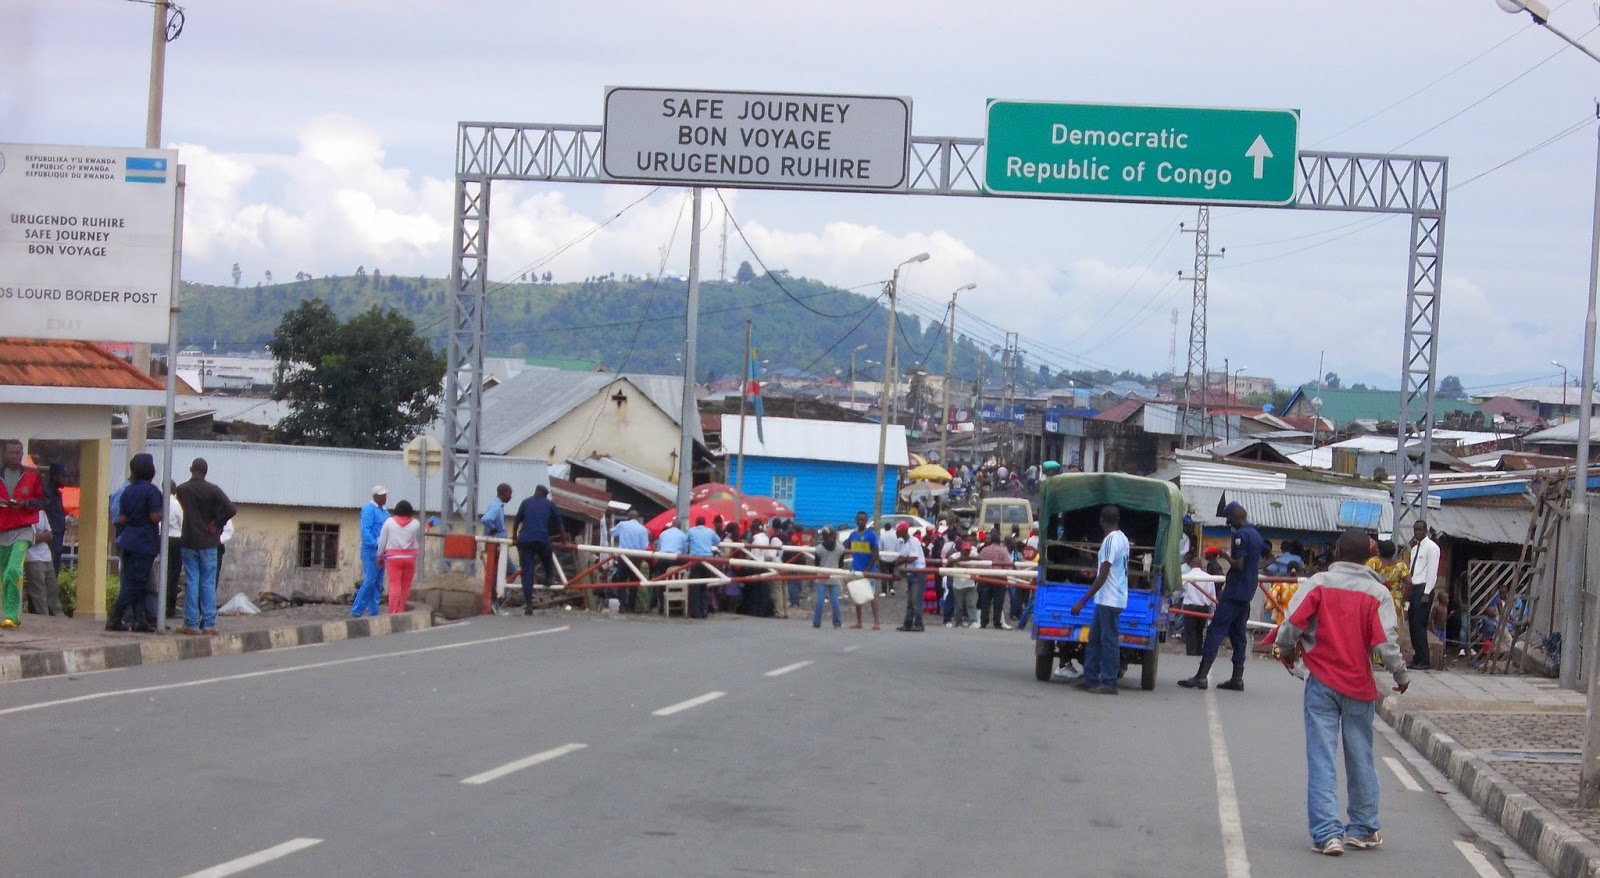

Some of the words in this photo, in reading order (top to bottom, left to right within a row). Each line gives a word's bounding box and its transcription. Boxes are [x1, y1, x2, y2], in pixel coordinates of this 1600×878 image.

[662, 98, 723, 119] SAFE
[737, 101, 850, 124] JOURNEY
[678, 125, 727, 146] BON
[740, 128, 832, 150] VOYAGE
[1051, 123, 1189, 149] Democratic
[25, 155, 69, 163] REPUBULIKA
[636, 151, 770, 175] URUGENDO
[780, 157, 871, 179] RUHIRE
[1006, 156, 1110, 183] Republic
[1122, 161, 1146, 182] of
[1157, 162, 1233, 190] Congo
[11, 214, 78, 226] URUGENDO
[82, 217, 125, 228] RUHIRE
[25, 229, 52, 239] SAFE
[56, 230, 110, 242] JOURNEY
[28, 245, 54, 254] BON
[59, 246, 107, 256] VOYAGE
[17, 288, 62, 300] LOURD
[65, 290, 120, 302] BORDER
[123, 292, 158, 304] POST
